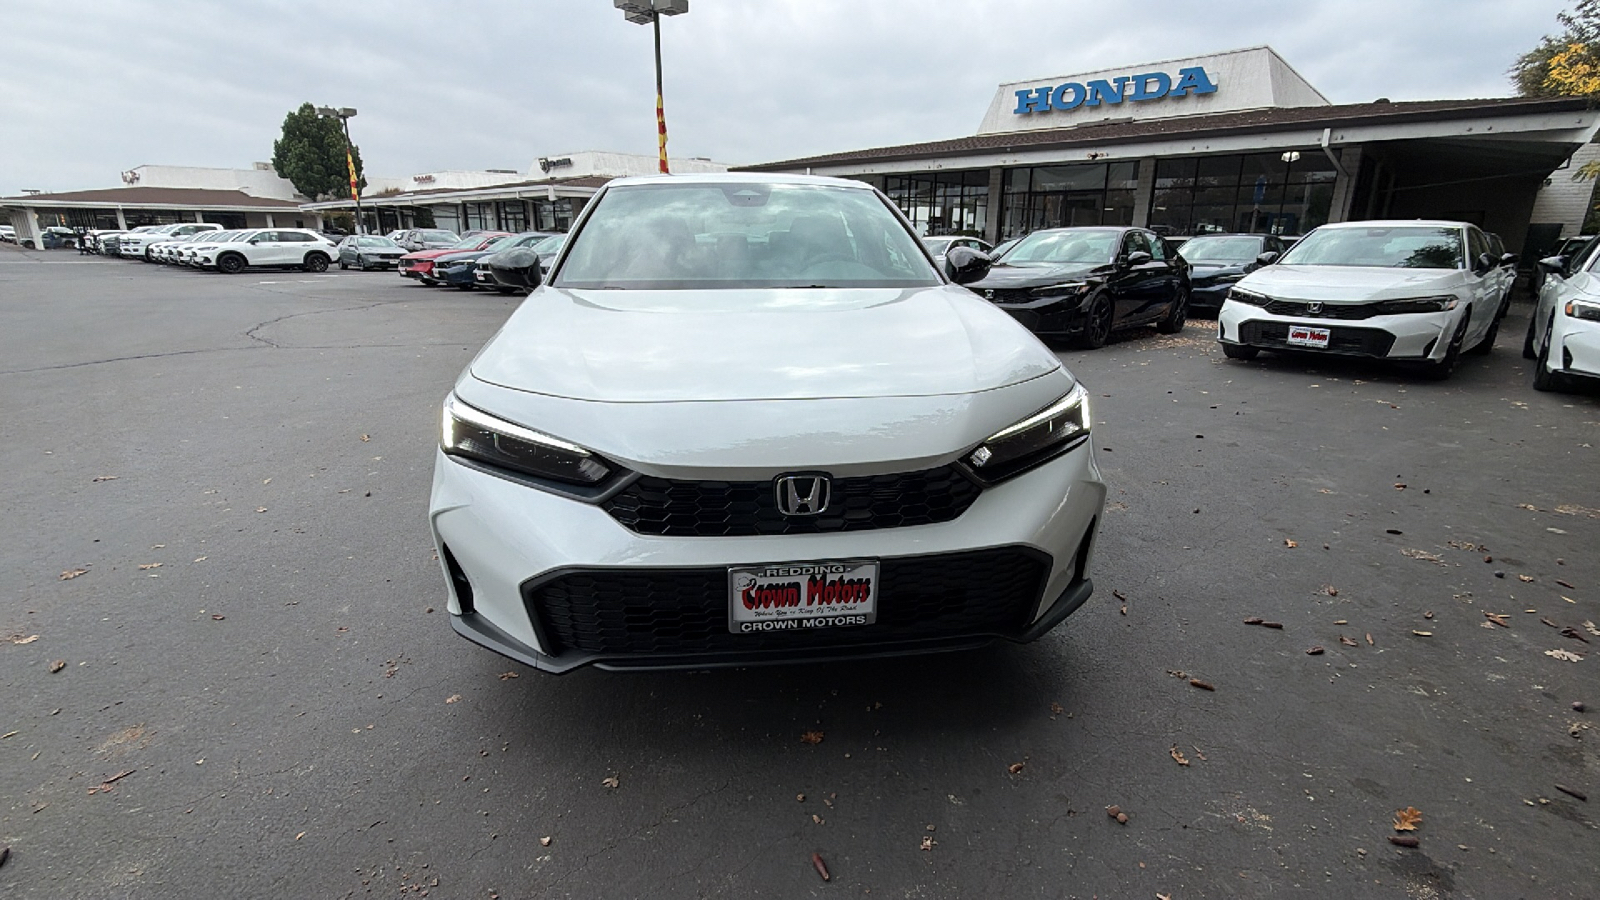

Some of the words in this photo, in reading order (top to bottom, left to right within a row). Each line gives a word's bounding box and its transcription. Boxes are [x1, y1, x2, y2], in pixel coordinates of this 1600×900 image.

[1014, 66, 1218, 114] HONDA
[766, 565, 844, 577] REDDING
[742, 577, 801, 610] Crown
[807, 575, 871, 606] Motors
[741, 619, 798, 632] CROWN
[802, 615, 866, 628] MOTORS
